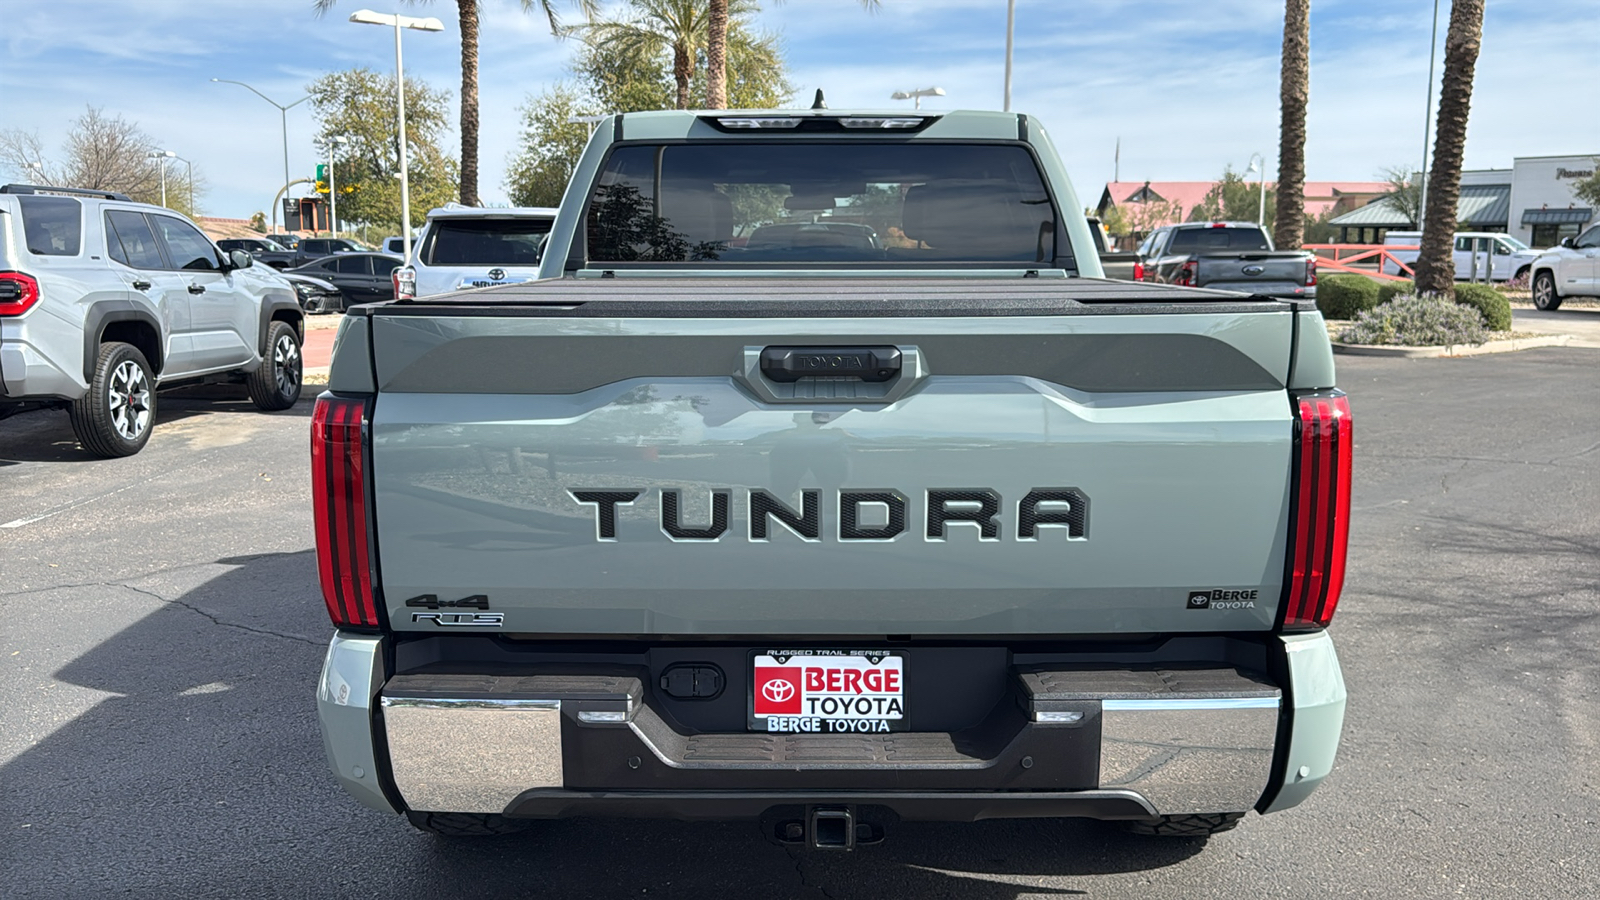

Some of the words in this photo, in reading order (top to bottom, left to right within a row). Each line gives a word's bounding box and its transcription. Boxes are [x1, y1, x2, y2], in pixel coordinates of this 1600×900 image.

[800, 355, 862, 368] TOYOTA
[567, 486, 1090, 542] TUNDRA
[1211, 589, 1258, 601] BERGE
[1210, 601, 1255, 609] TOYOTA
[411, 612, 504, 627] RTS
[805, 667, 900, 695] BERGE
[806, 697, 904, 715] TOYOTA
[767, 716, 821, 733] BERGE
[826, 719, 890, 732] TOYOTA
